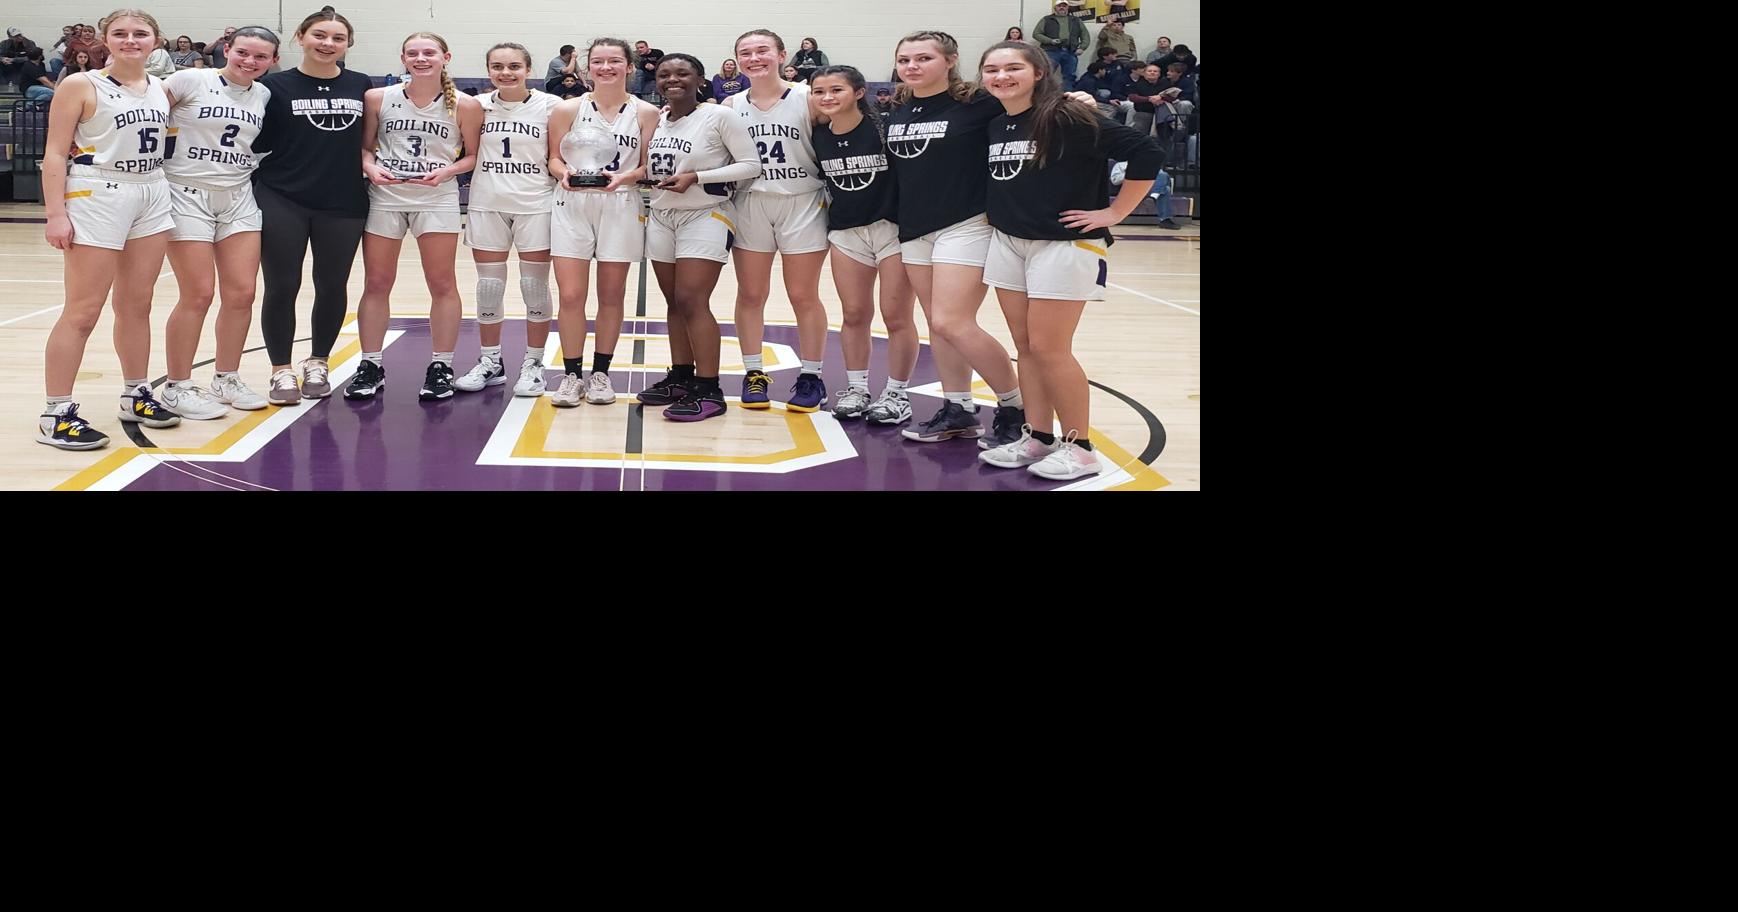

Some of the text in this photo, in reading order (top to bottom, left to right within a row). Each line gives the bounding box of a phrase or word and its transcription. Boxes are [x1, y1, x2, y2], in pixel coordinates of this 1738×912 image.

[291, 98, 328, 111] BOILING
[219, 124, 240, 147] 2
[385, 119, 449, 139] BOILING
[747, 123, 800, 140] OILING
[906, 120, 949, 135] SPRINGS
[137, 127, 159, 153] 15
[407, 135, 422, 157] 3
[501, 136, 512, 158] 1
[187, 146, 252, 167] SPRINGS
[756, 140, 786, 164] 24
[845, 154, 888, 169] SPRINGS
[481, 160, 541, 174] SPRINGS
[761, 167, 808, 180] RINGS
